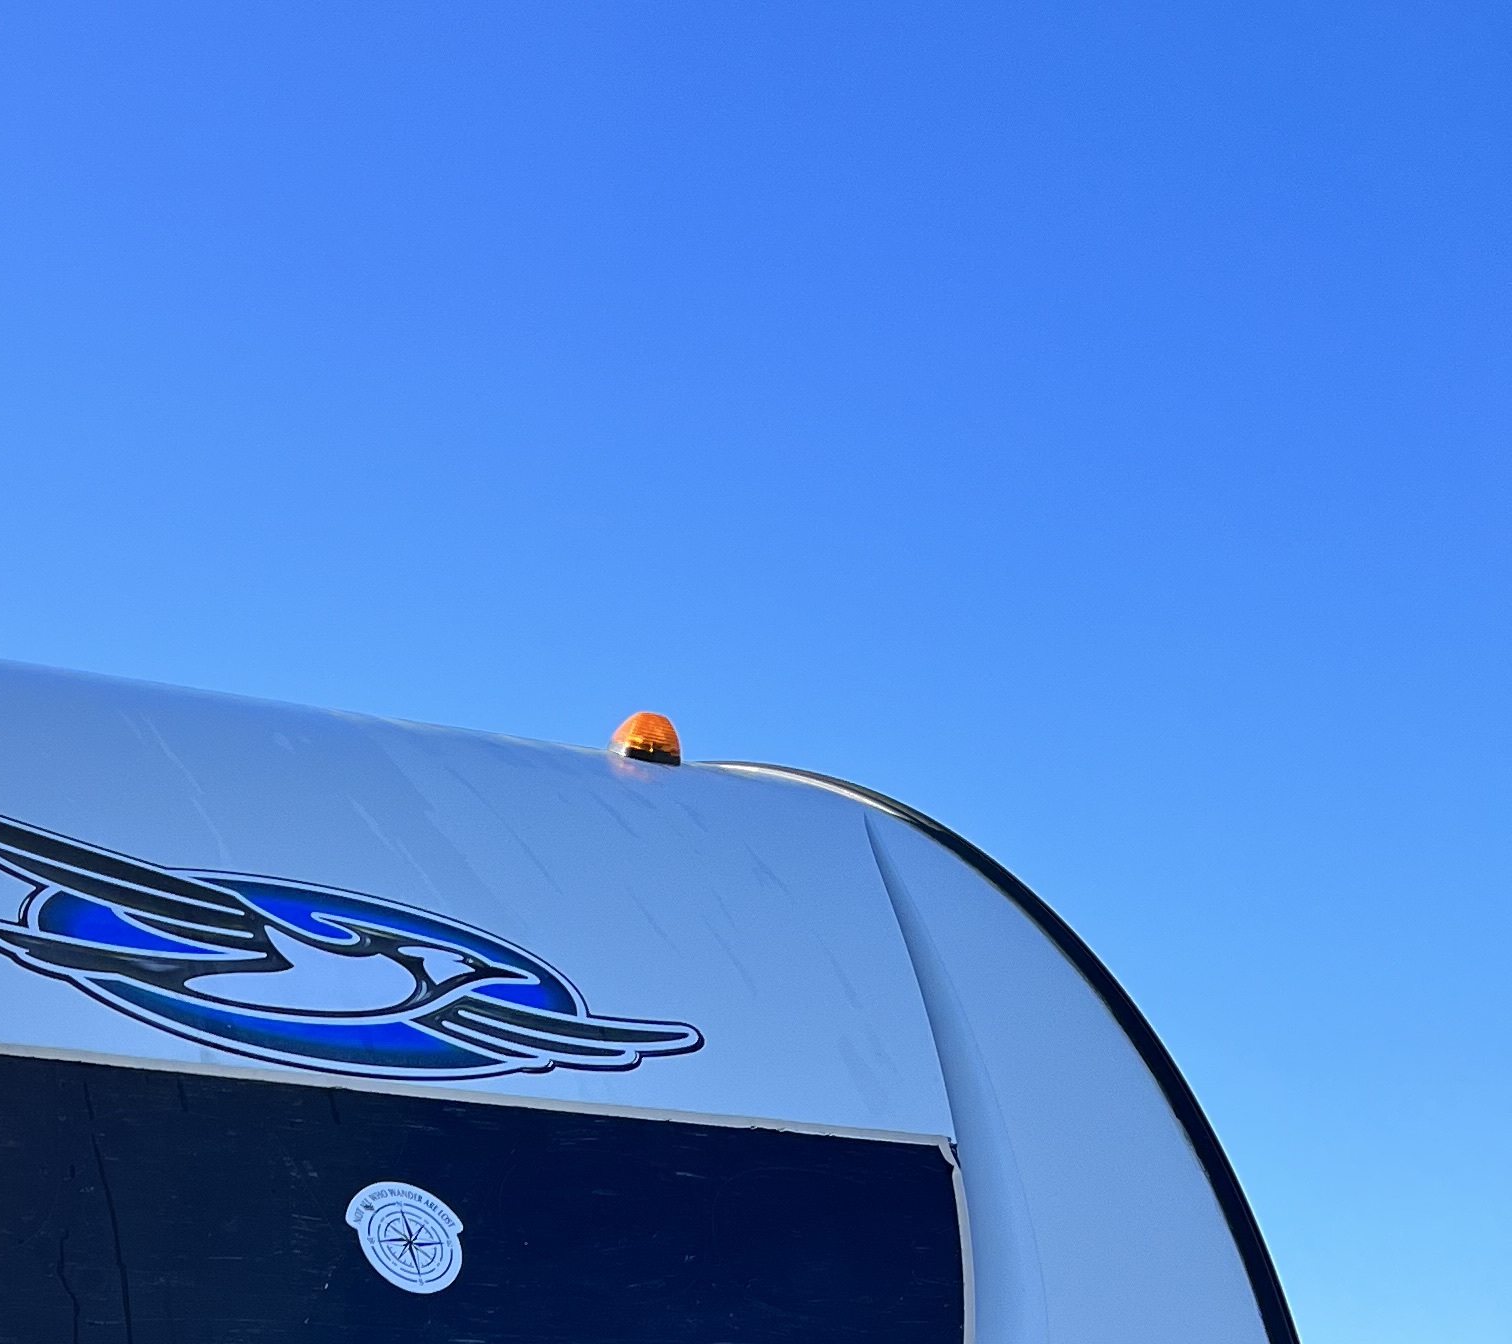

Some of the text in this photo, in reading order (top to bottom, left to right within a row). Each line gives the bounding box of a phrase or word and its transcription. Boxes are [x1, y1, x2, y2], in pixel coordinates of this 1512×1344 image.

[369, 1190, 388, 1202] WHO
[388, 1188, 423, 1202] WANDER
[424, 1199, 438, 1212] ARE
[438, 1210, 455, 1227] LOST
